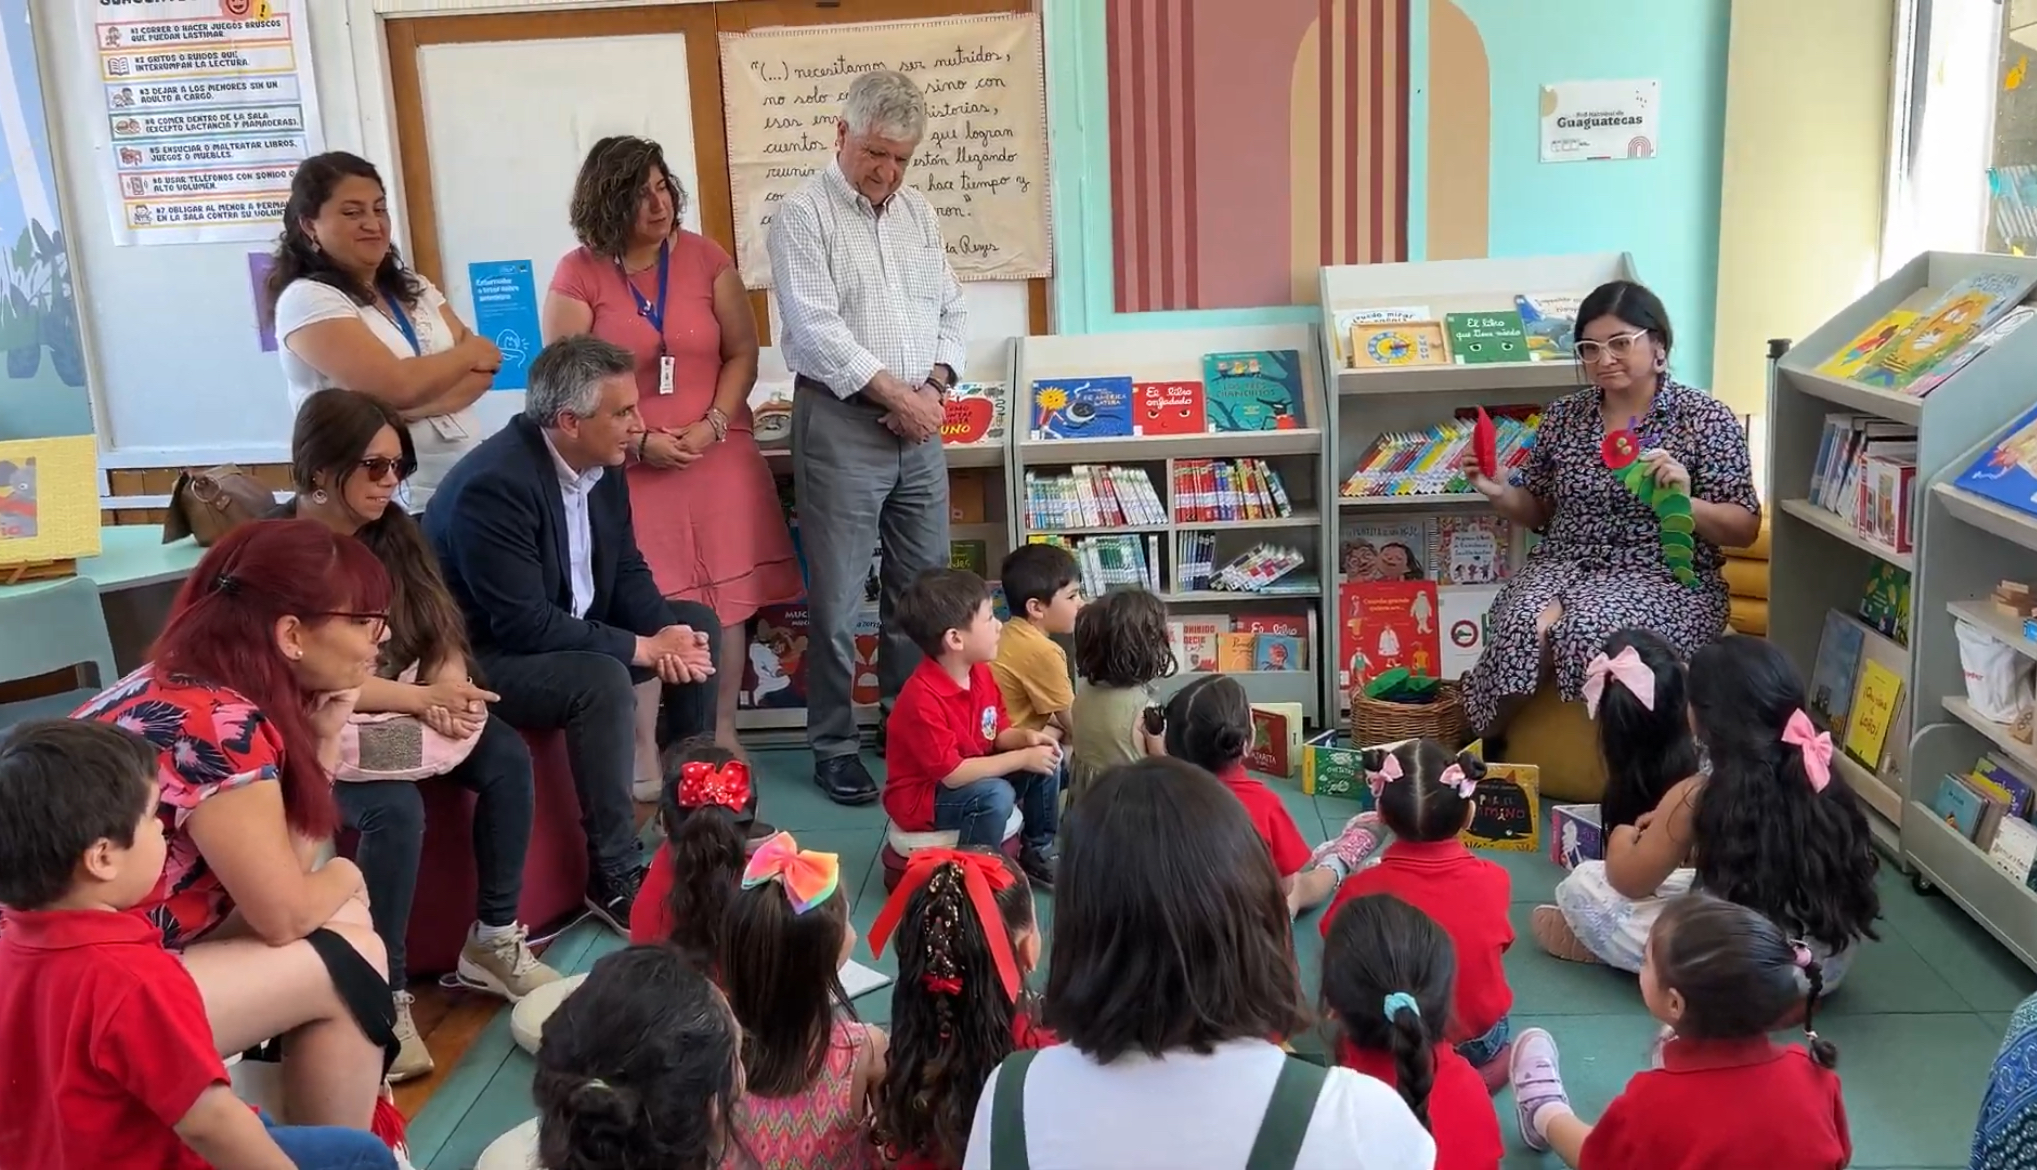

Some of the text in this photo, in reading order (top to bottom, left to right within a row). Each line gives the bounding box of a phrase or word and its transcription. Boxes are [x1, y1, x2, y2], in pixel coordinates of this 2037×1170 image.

[141, 26, 170, 34] CORRER
[182, 24, 208, 32] HACER
[211, 22, 242, 30] JUEGOS
[245, 20, 281, 29] BRUSCOS
[131, 34, 147, 42] QUE
[150, 33, 180, 41] PUEDAN
[147, 54, 176, 62] GRITOS
[188, 52, 219, 61] RUIDOS
[794, 55, 886, 78] necesitamos
[899, 61, 925, 72] ser
[934, 45, 1011, 68] nutridos,
[136, 60, 192, 71] INTERRUMPAN
[195, 60, 206, 68] LA
[152, 86, 177, 94] DEJAR
[189, 84, 205, 92] LOS
[208, 82, 247, 91] MENORES
[250, 81, 264, 89] SIN
[266, 80, 278, 88] UN
[763, 96, 785, 106] no
[794, 85, 829, 104] solo
[925, 79, 966, 94] sino
[975, 78, 1006, 89] con
[141, 94, 172, 103] ADULTO
[157, 116, 184, 124] COMER
[187, 114, 218, 123] DENTRO
[220, 113, 231, 121] DE
[247, 112, 269, 120] SALA
[764, 117, 803, 129] esas
[924, 102, 998, 118] historias,
[186, 121, 231, 131] LACTANCIA
[1557, 116, 1643, 130] Guaguatecas
[763, 120, 1013, 153] cuentos que logran
[163, 144, 201, 153] ENSUCIAR
[213, 141, 262, 150] MALTRATAR
[151, 153, 182, 162] JUEGOS
[913, 151, 949, 167] están
[956, 146, 1017, 171] llegando
[165, 175, 186, 184] USAR
[189, 173, 234, 183] TELÉFONOS
[255, 170, 286, 180] SONIDO
[928, 173, 954, 191] hace
[961, 171, 1010, 194] tiempo
[1016, 176, 1030, 192] y
[154, 184, 174, 192] ALTO
[168, 204, 202, 213] OBLIGAR
[205, 204, 216, 212] AL
[218, 202, 245, 211] MENOR
[157, 213, 167, 221] EN
[170, 213, 180, 221] LA
[183, 212, 204, 220] SALA
[207, 211, 238, 219] CONTRA
[241, 210, 252, 218] SU
[960, 235, 999, 258] Reyes
[1467, 317, 1505, 328] El libro
[1456, 330, 1471, 341] que
[1146, 387, 1192, 398] El libro
[1146, 397, 1193, 410] enfadado
[941, 424, 971, 435] UNO
[1183, 625, 1215, 634] OHIBIDO
[1251, 622, 1298, 635] El libro
